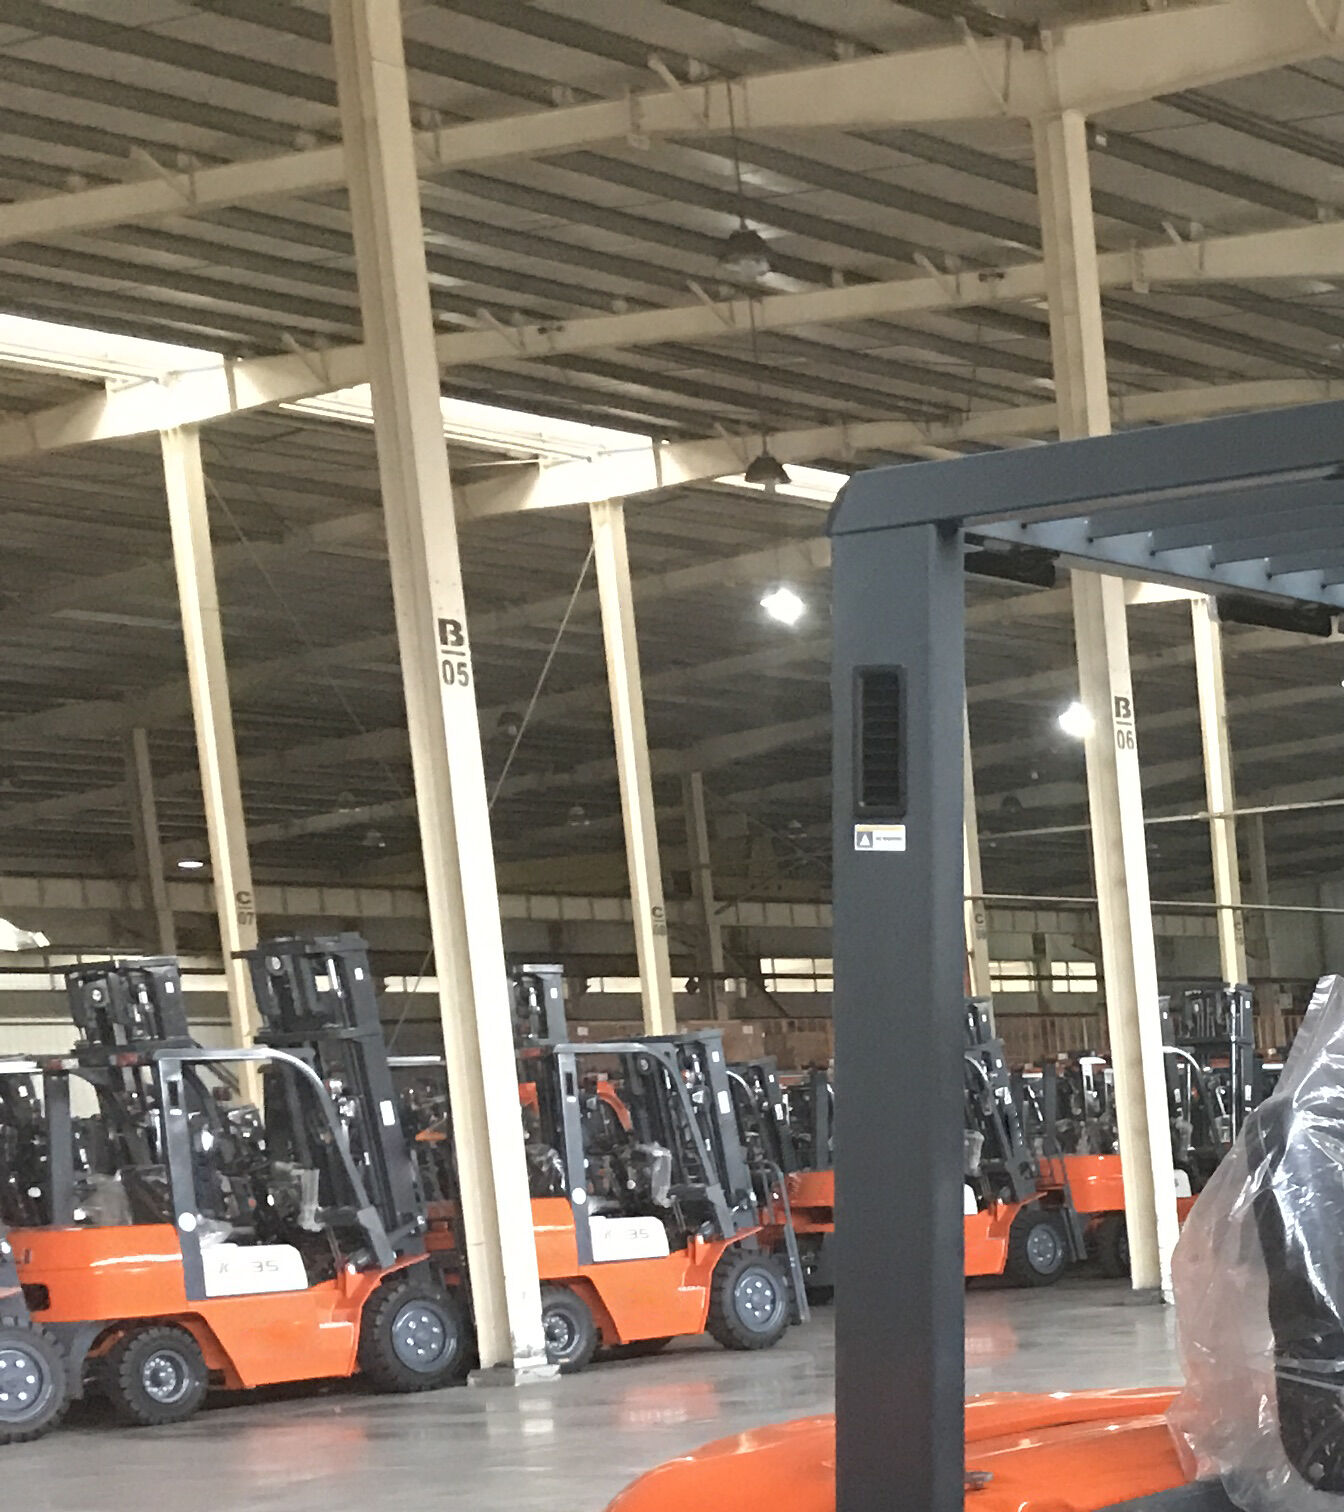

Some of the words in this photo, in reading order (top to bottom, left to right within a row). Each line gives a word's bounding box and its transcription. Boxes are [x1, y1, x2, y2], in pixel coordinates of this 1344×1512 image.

[438, 618, 465, 646] B
[442, 659, 470, 687] 05
[1114, 696, 1132, 718] B
[1117, 729, 1135, 750] 06
[236, 891, 252, 905] C
[238, 911, 255, 926] 07
[652, 906, 664, 918] C
[975, 913, 985, 924] C
[248, 1260, 279, 1273] 35
